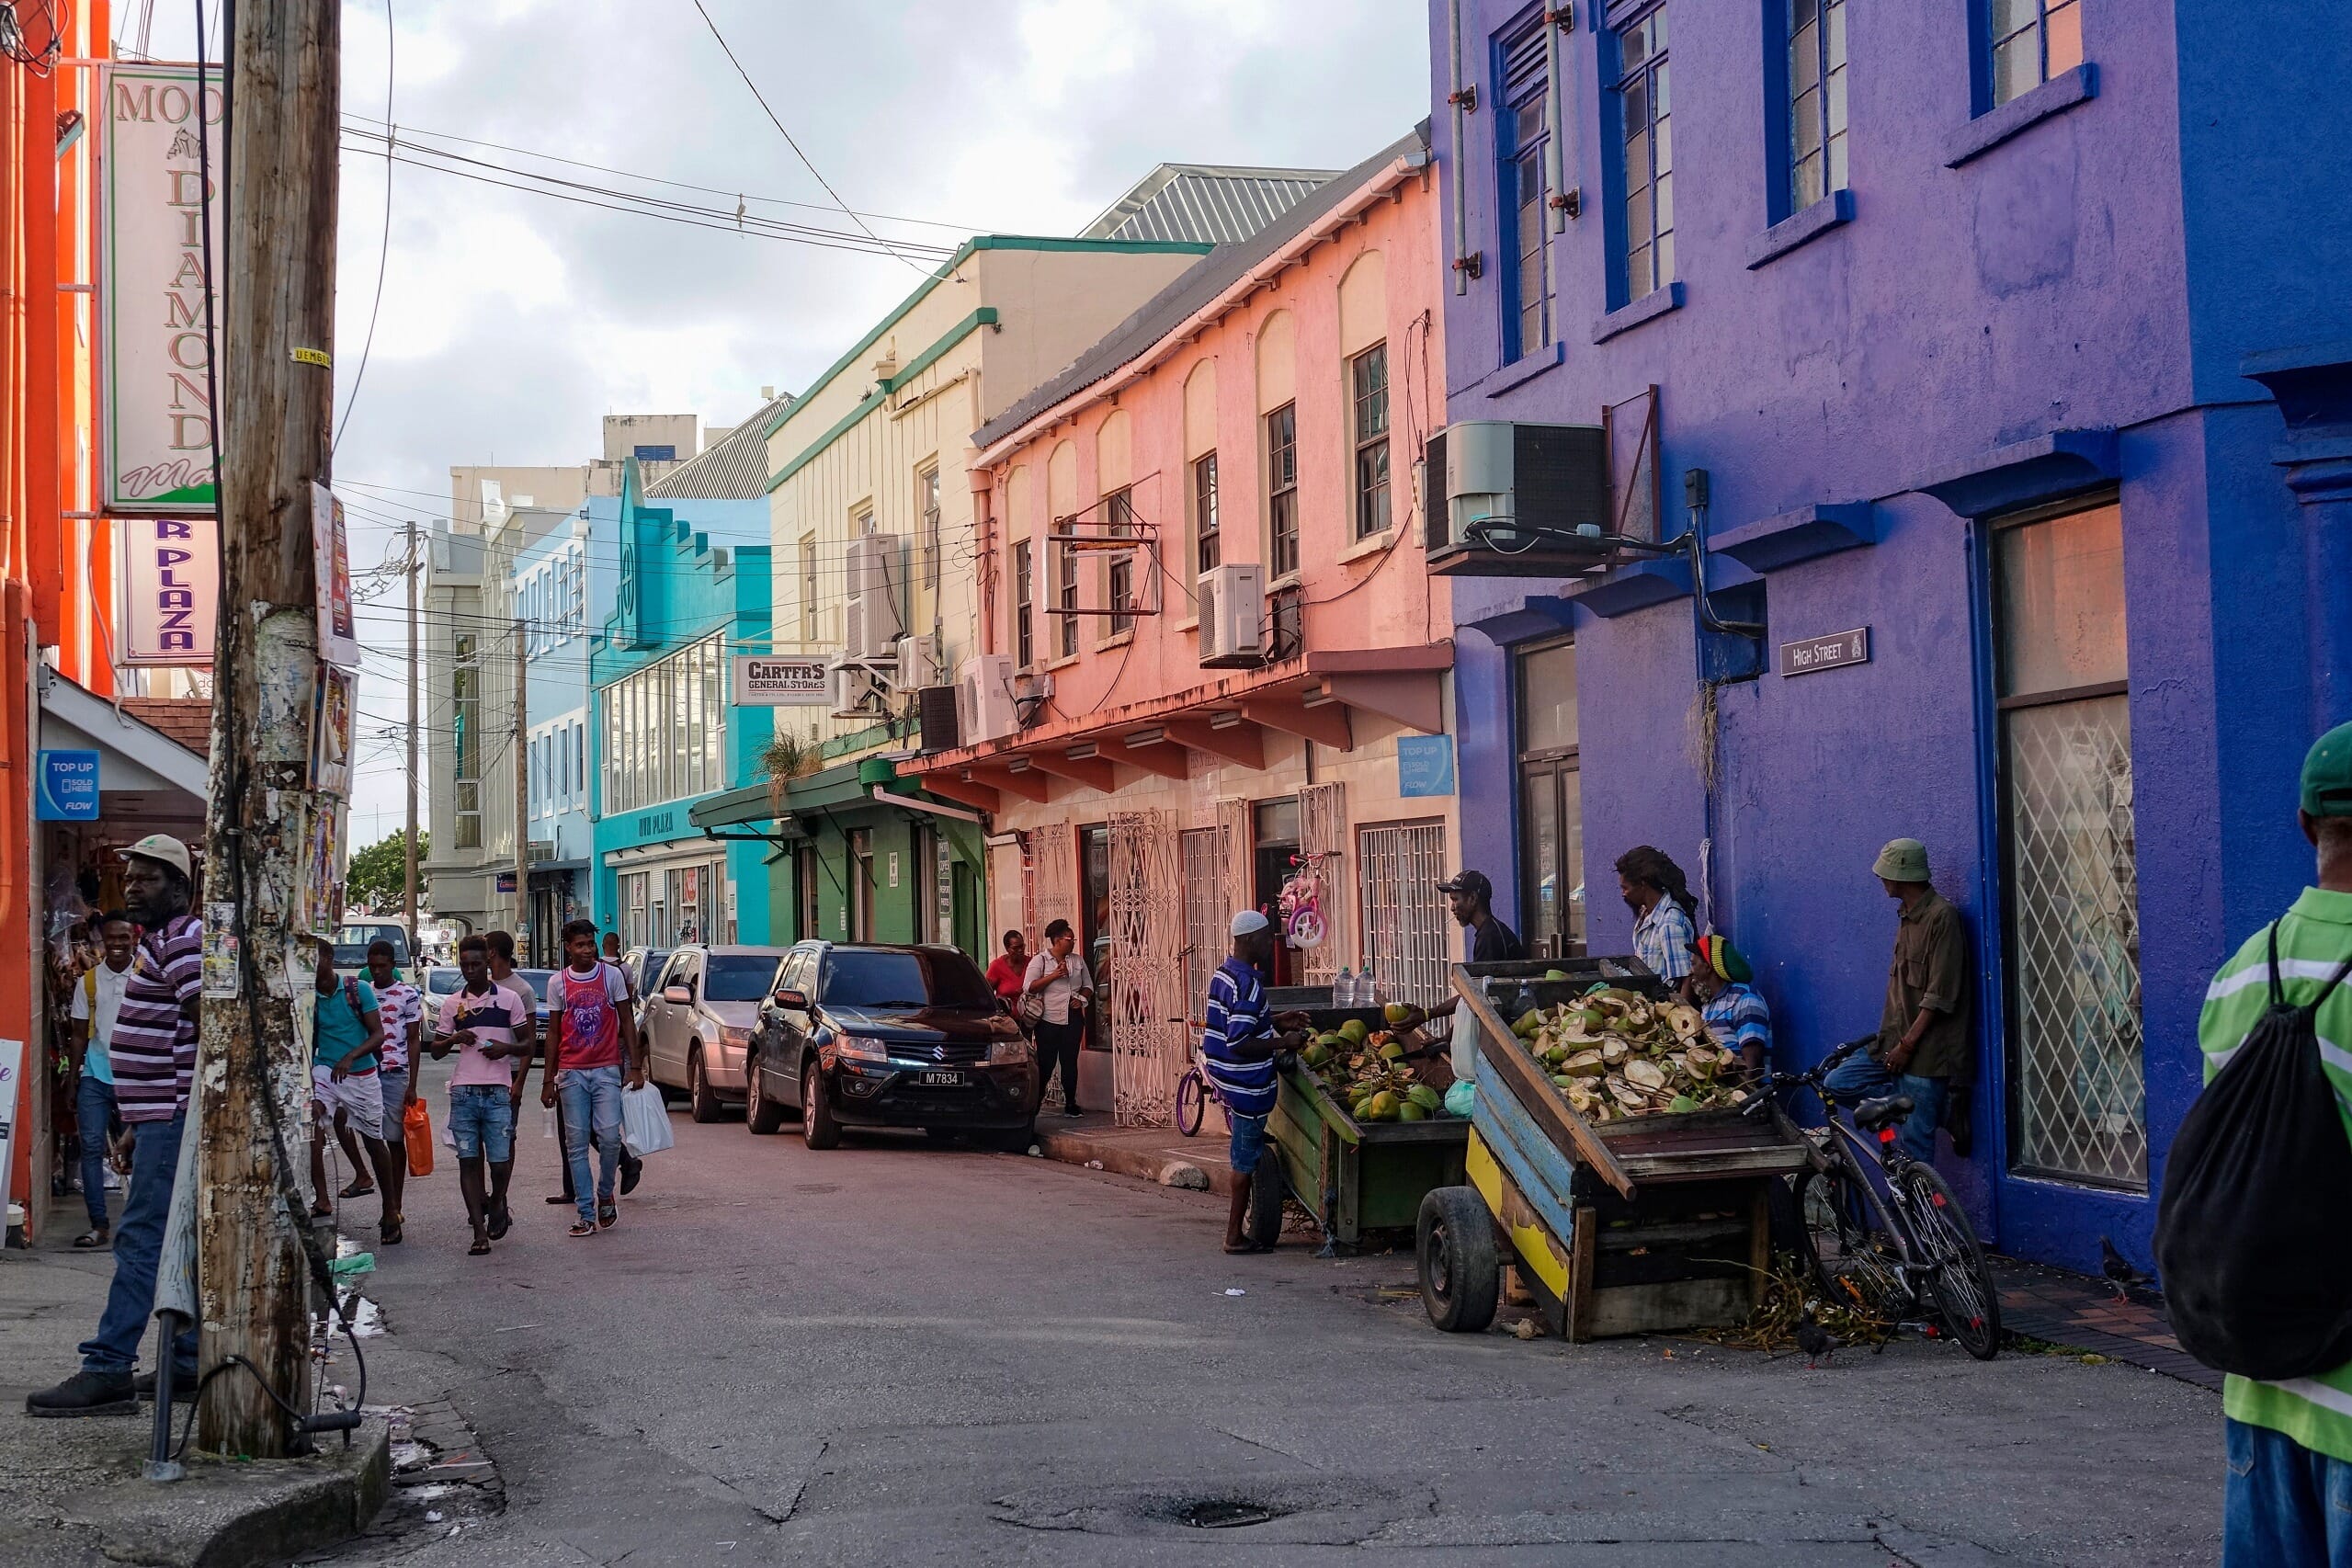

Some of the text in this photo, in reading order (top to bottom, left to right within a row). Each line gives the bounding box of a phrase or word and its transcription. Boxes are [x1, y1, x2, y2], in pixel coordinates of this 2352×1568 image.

[164, 169, 220, 451] DIAMOND
[157, 548, 194, 651] PLAZA
[52, 763, 94, 772] TOP UP
[65, 801, 93, 810] FLOW
